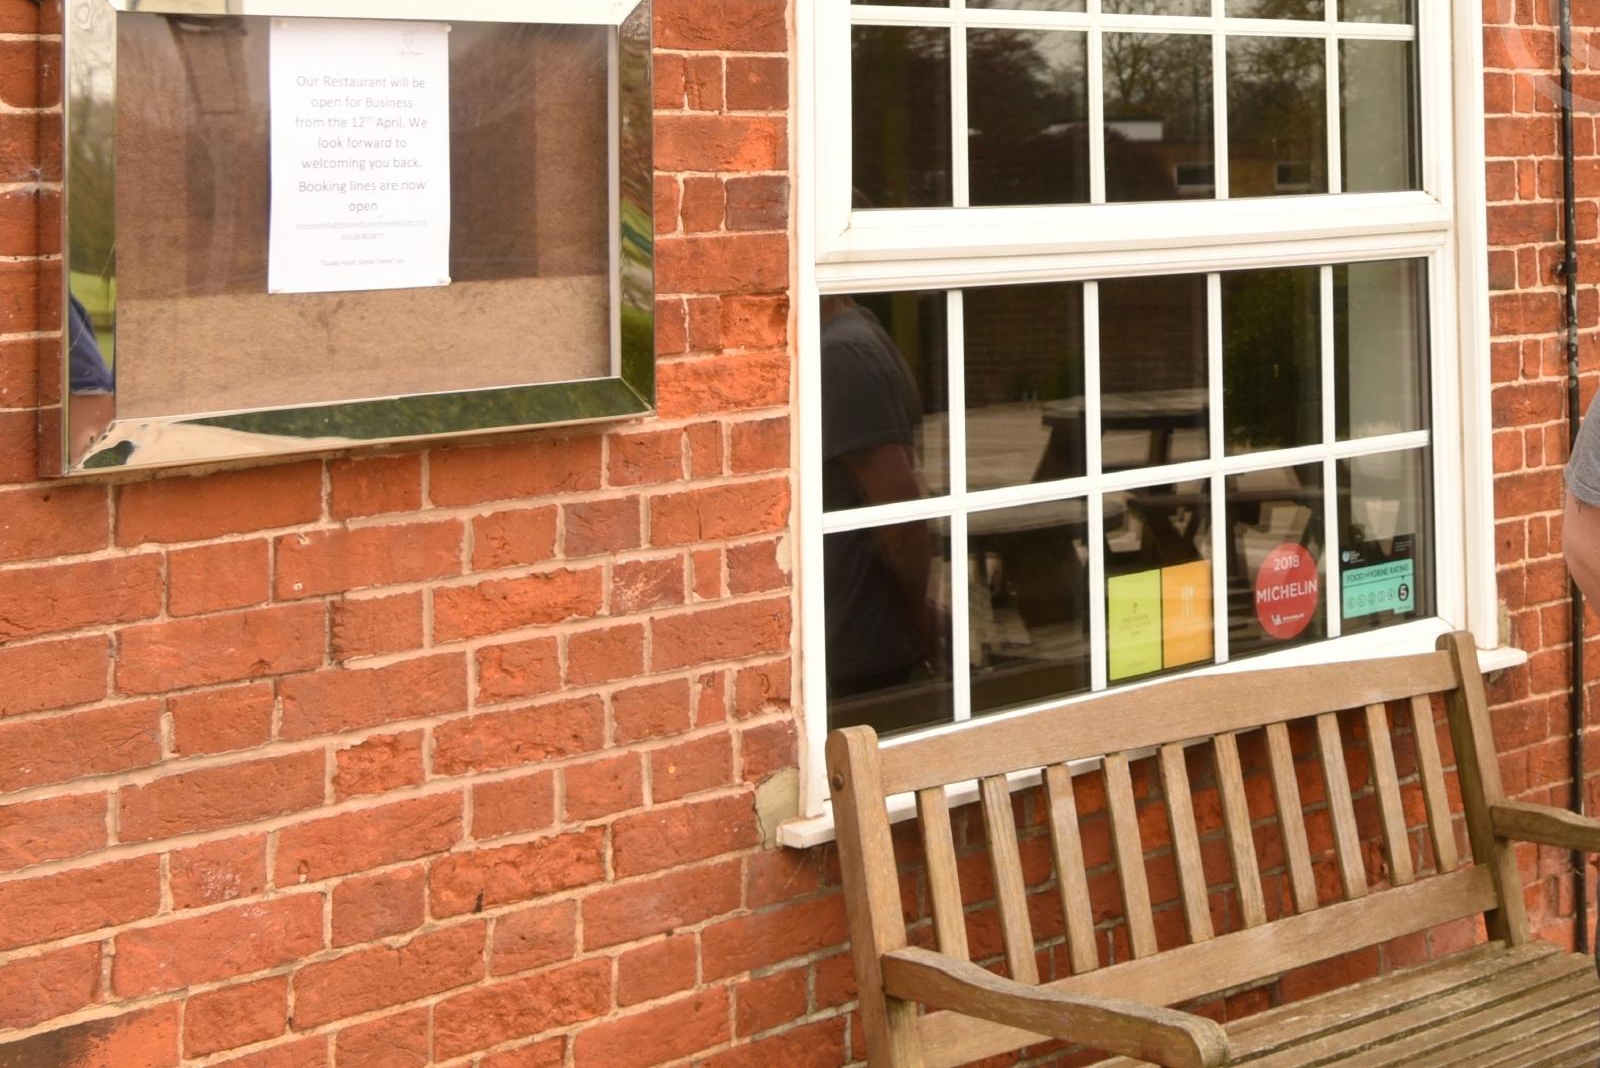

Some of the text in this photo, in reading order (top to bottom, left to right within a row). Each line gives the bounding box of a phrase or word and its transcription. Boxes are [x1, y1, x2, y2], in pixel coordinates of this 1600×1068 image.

[296, 75, 426, 89] Our Restaurant will be
[310, 96, 414, 110] open for Business
[295, 116, 325, 128] from
[327, 117, 348, 128] the
[375, 117, 406, 130] April.
[408, 117, 428, 128] We
[317, 136, 407, 149] look forward to
[301, 157, 366, 171] welcoming
[368, 159, 390, 171] you
[298, 180, 426, 194] Booking lines are now
[348, 202, 378, 214] open
[1274, 555, 1300, 571] 2018
[1346, 572, 1365, 583] FOOD
[1256, 579, 1318, 604] MICHELIN
[1399, 584, 1408, 600] 5
